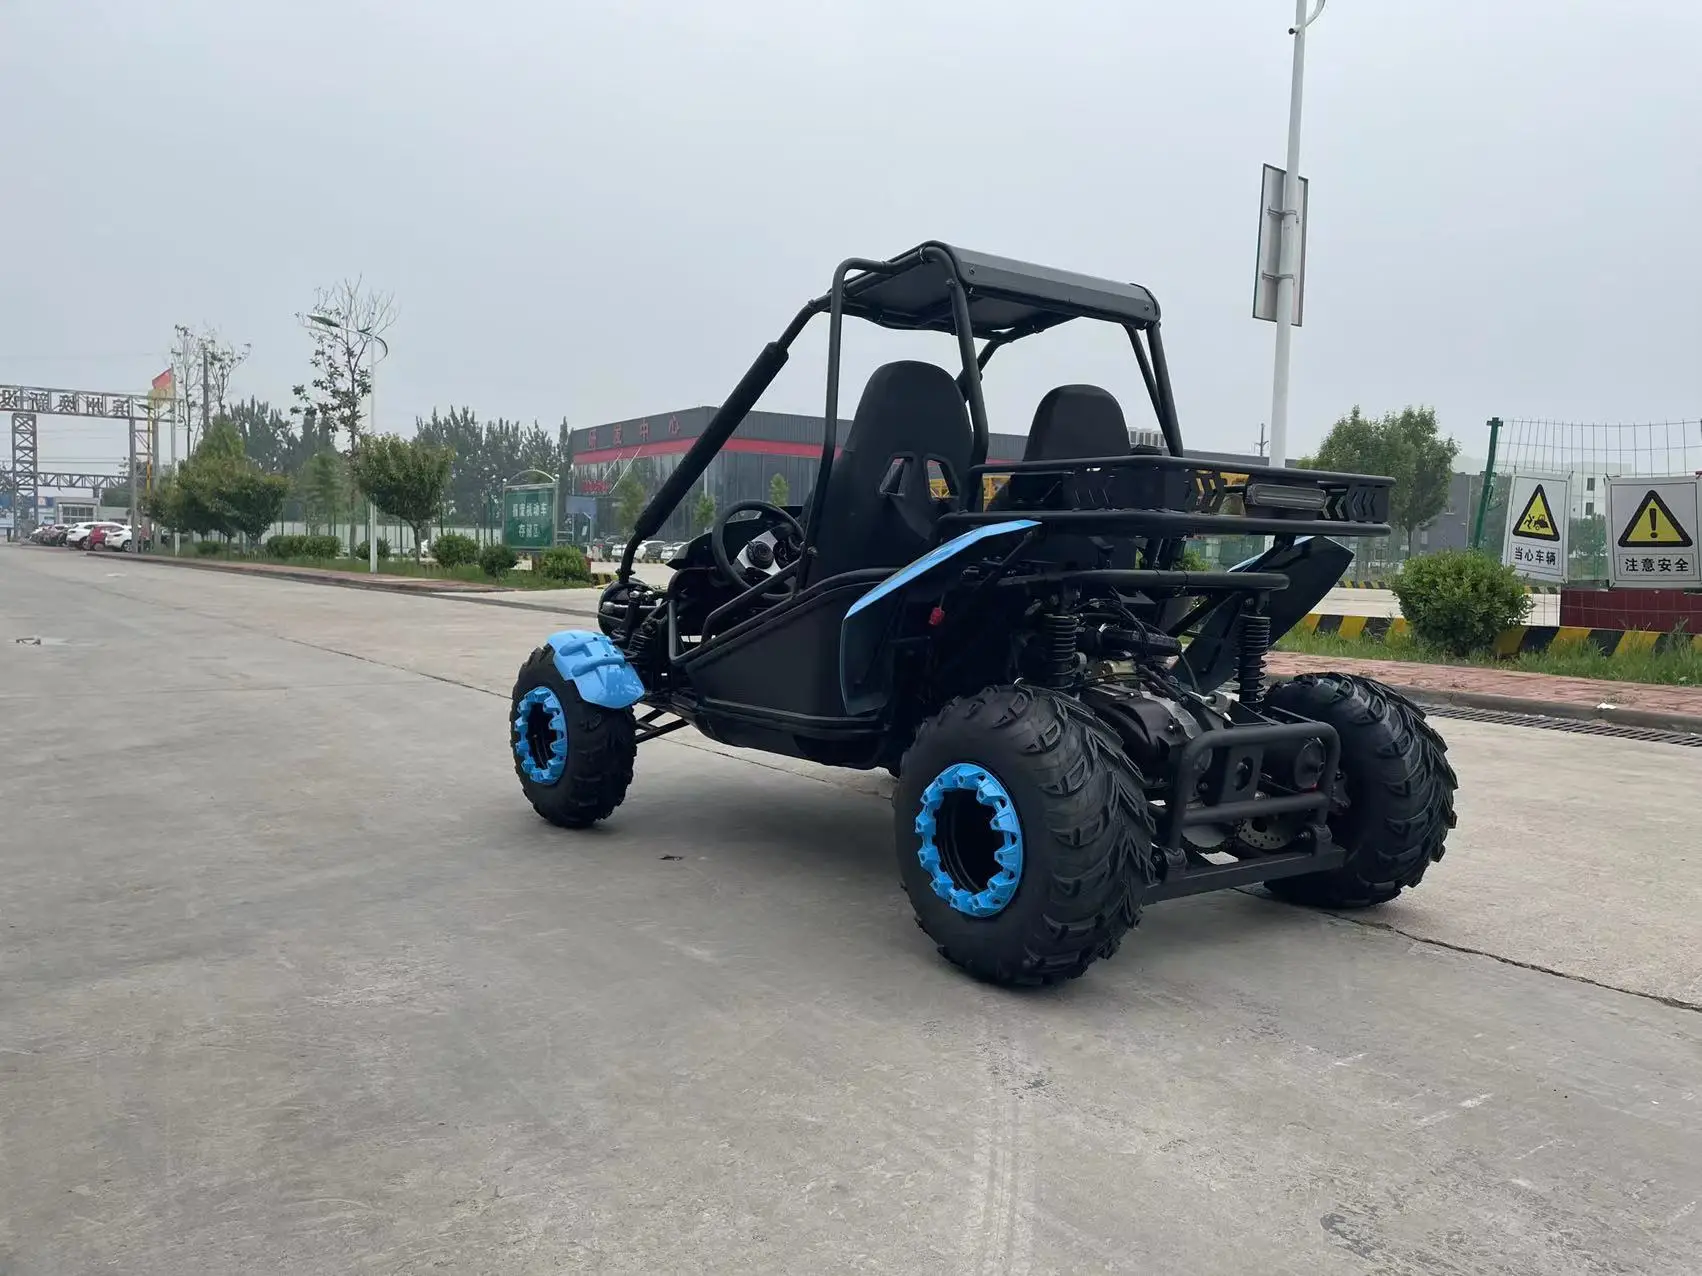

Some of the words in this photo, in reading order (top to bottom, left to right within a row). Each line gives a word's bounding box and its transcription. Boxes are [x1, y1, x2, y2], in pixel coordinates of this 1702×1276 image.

[588, 415, 680, 451] 研发中心
[1514, 547, 1557, 566] 当心车辆
[1625, 557, 1689, 572] 注意安全
